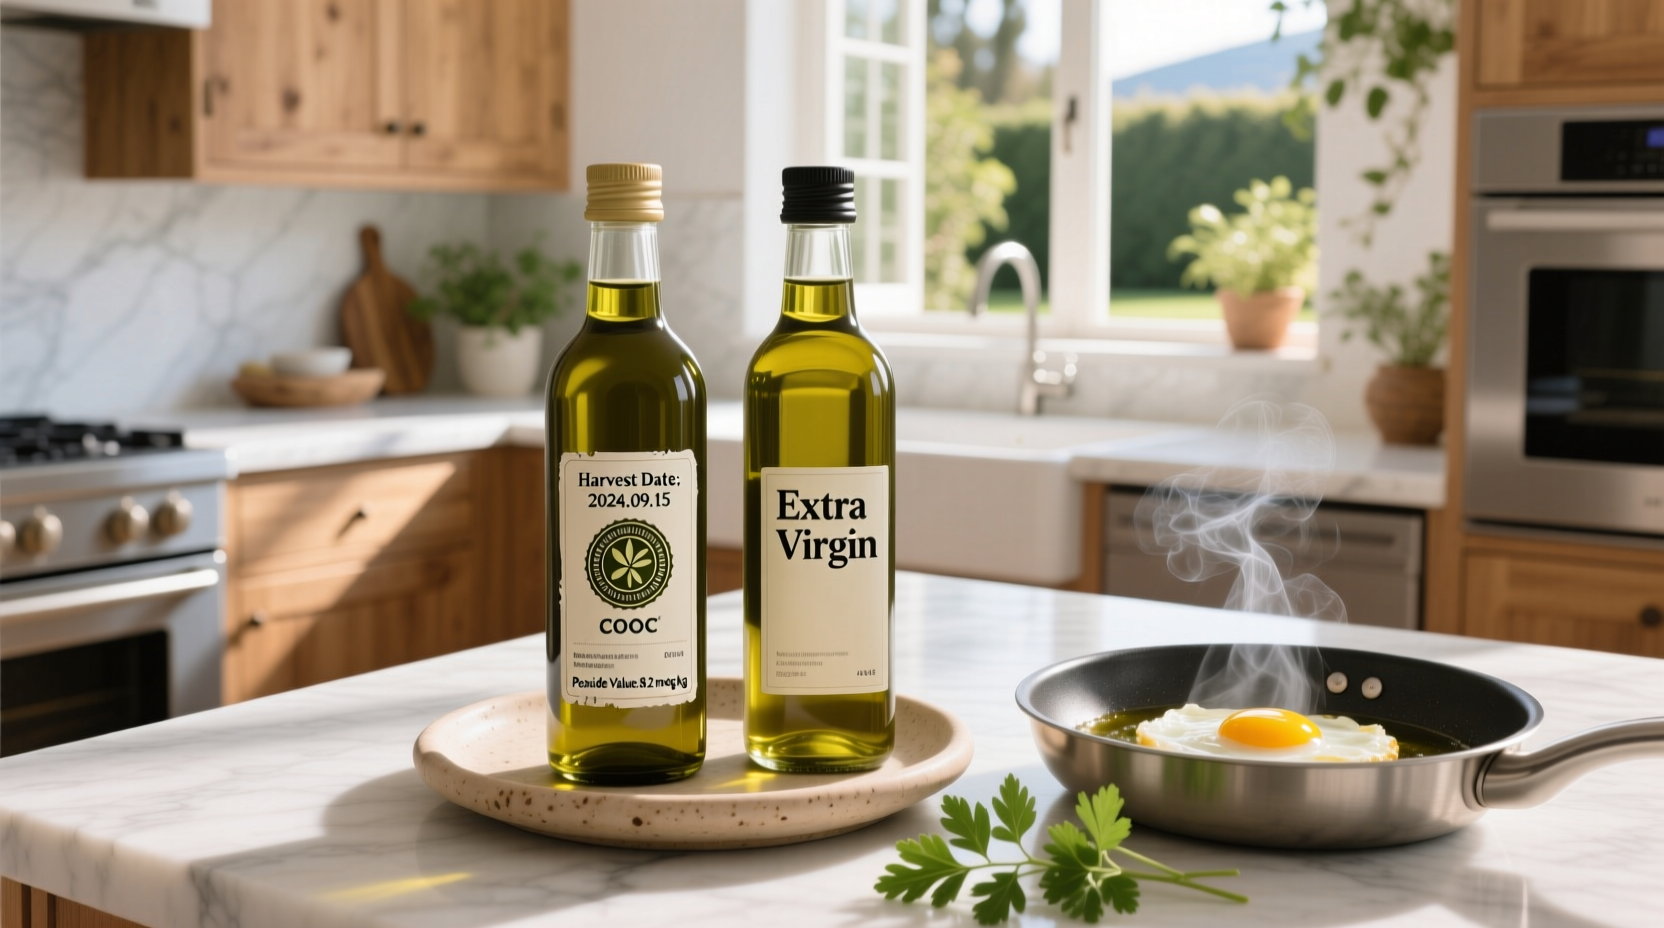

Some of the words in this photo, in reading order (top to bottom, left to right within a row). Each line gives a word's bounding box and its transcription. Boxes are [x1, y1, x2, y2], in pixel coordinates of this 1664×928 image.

[578, 472, 638, 487] Harvest
[588, 491, 671, 508] 2024.09.15
[776, 489, 867, 521] Extra
[775, 528, 878, 569] Virgin
